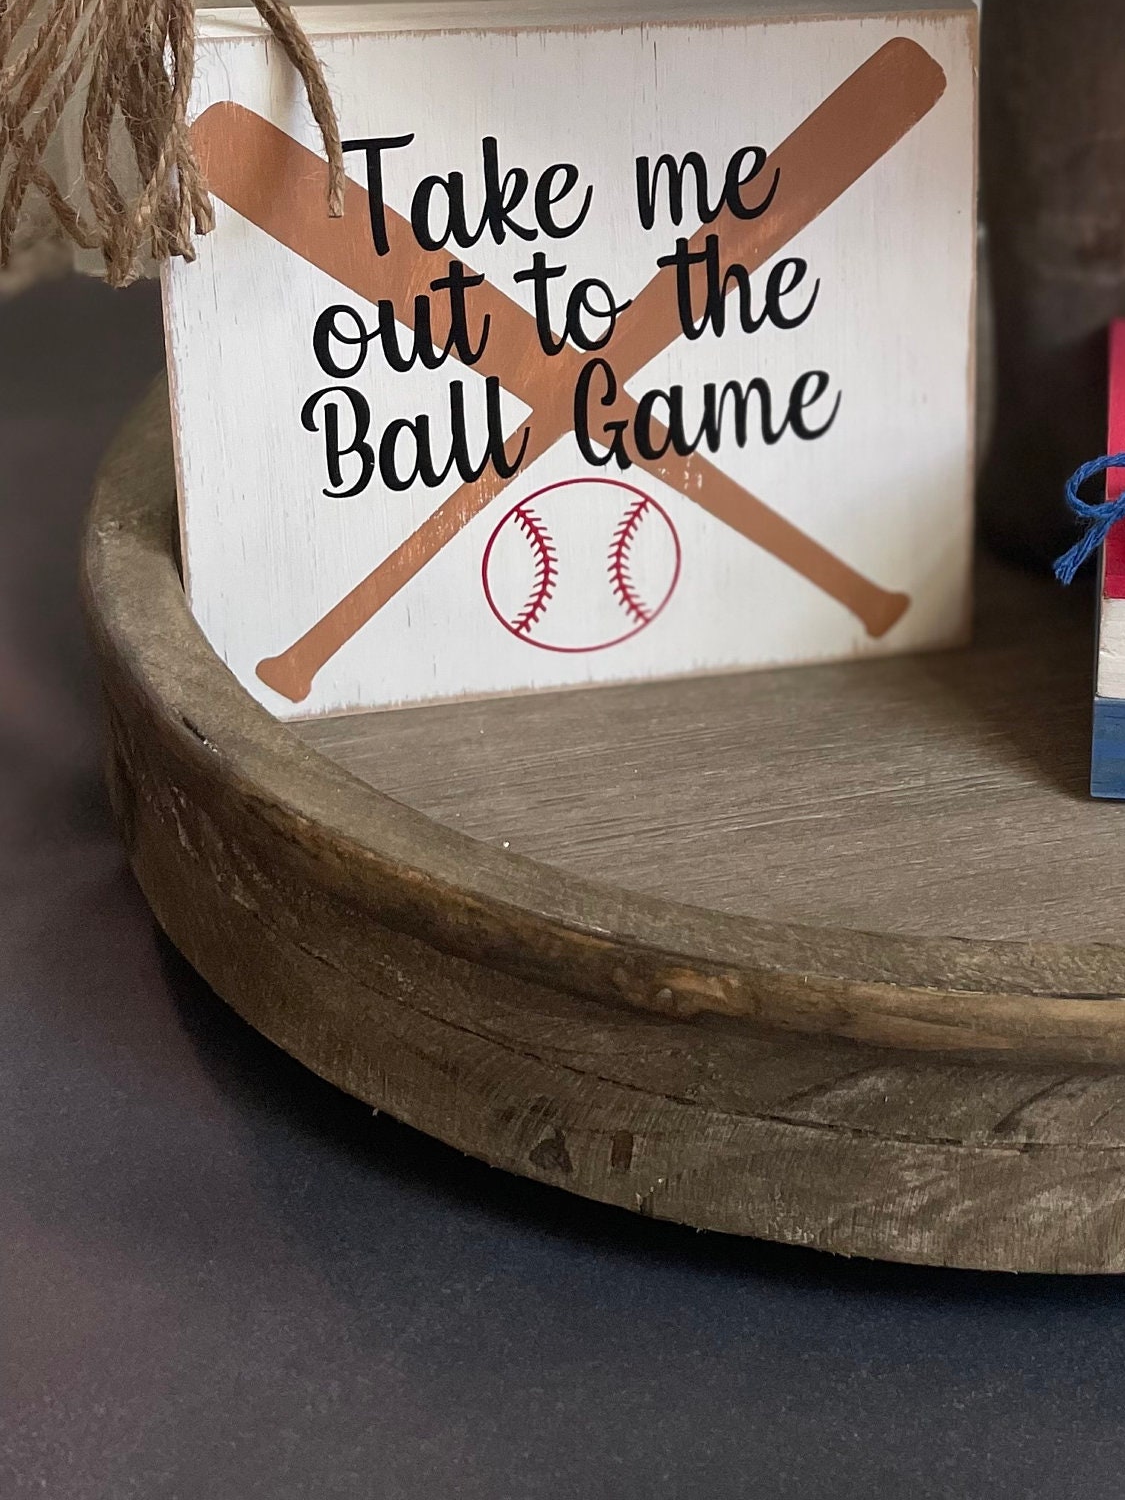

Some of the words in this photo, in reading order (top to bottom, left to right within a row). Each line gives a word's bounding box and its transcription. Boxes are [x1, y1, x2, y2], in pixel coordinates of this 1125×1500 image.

[341, 133, 593, 257] Take
[635, 145, 781, 231] me
[313, 260, 491, 379] out
[513, 252, 633, 357] to
[657, 234, 820, 341] the
[301, 376, 530, 498] Ball
[573, 357, 842, 471] Game
